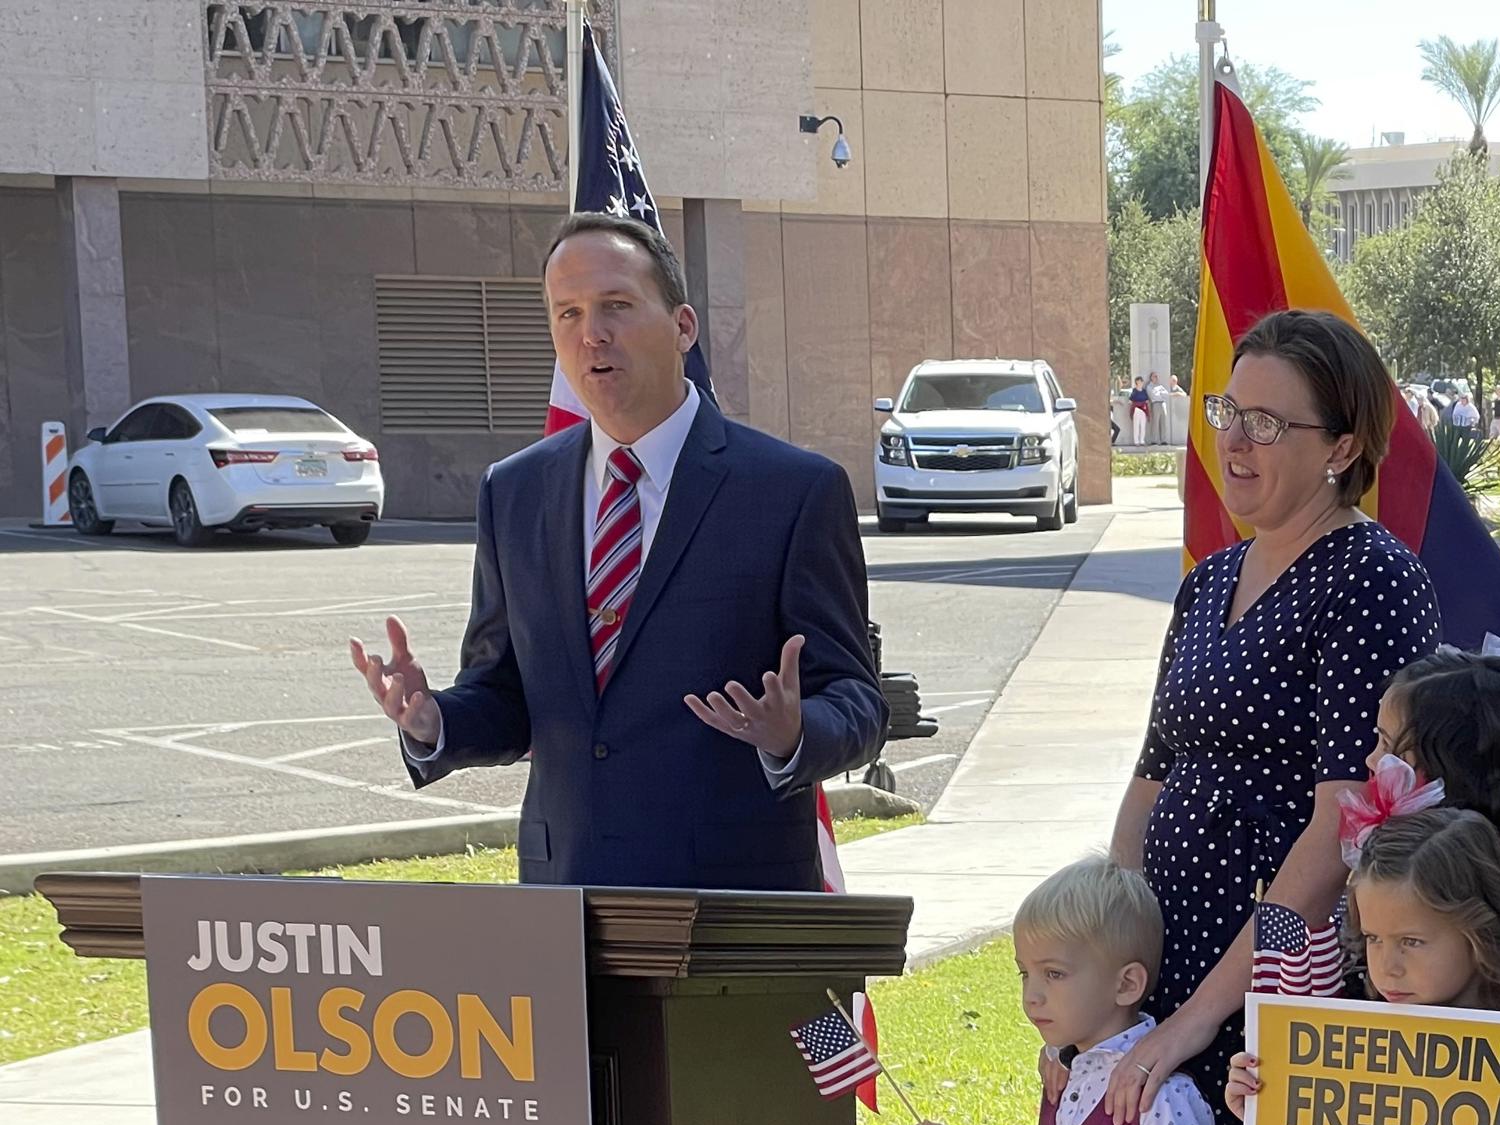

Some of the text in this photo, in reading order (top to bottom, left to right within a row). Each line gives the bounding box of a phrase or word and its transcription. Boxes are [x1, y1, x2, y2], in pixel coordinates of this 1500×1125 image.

[187, 919, 383, 977] JUSTIN
[188, 982, 535, 1082] OLSON
[201, 1085, 540, 1121] FOR U.S. SENATE
